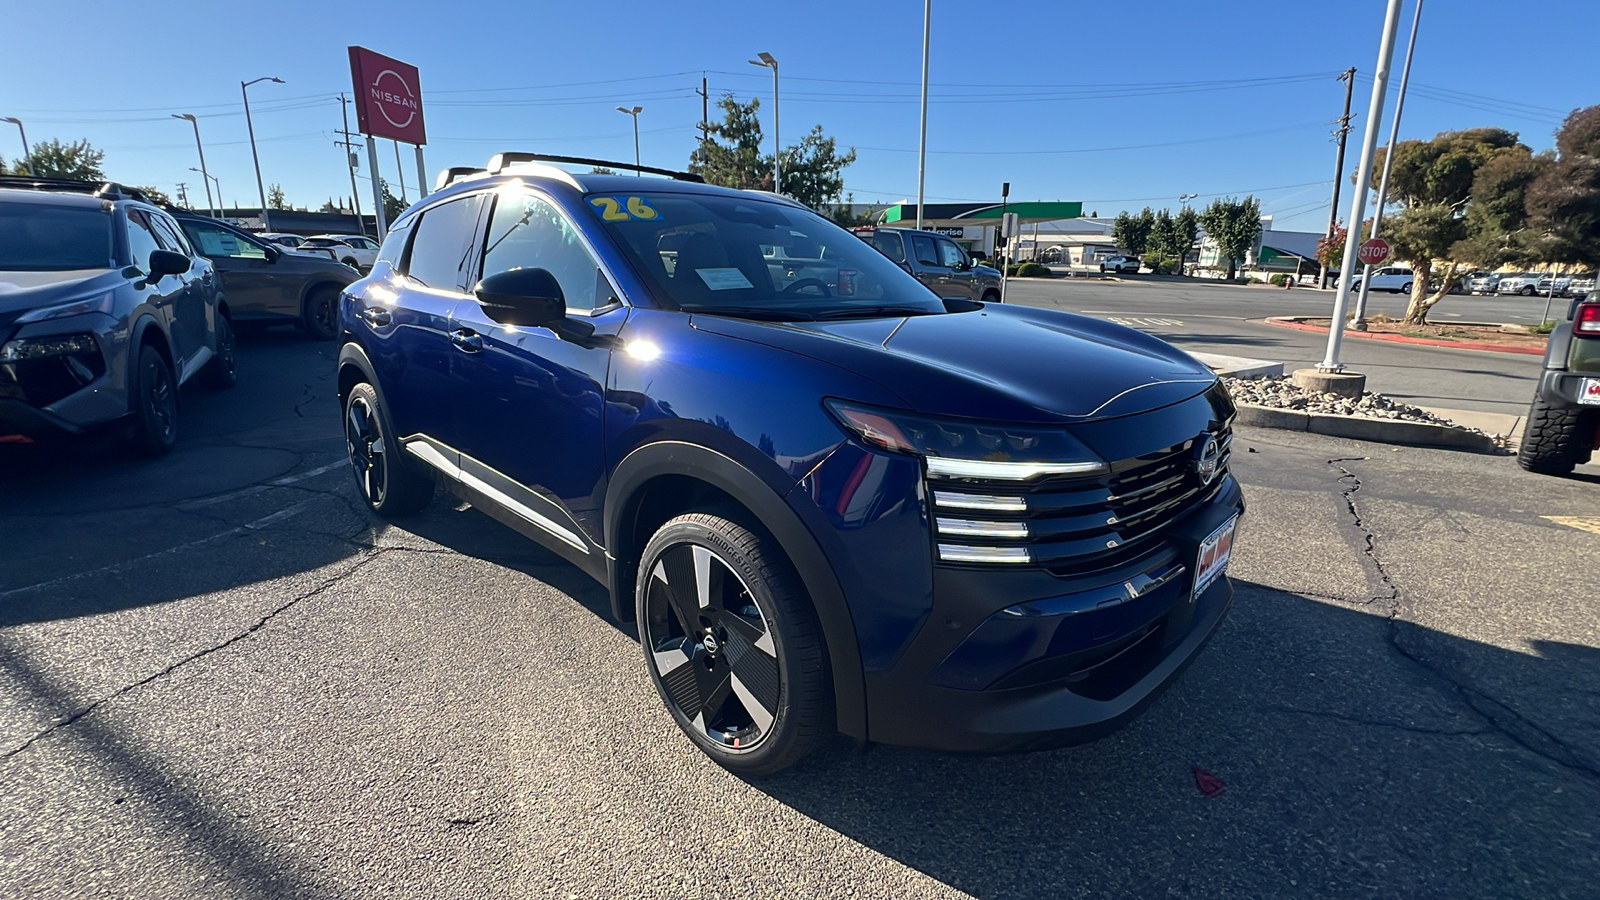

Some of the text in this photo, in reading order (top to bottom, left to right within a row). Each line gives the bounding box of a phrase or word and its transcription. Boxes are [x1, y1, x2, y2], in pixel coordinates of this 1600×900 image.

[371, 88, 417, 110] NISSAN
[590, 196, 658, 220] 26
[1361, 246, 1387, 257] STOP
[1107, 317, 1184, 327] STOP
[706, 531, 761, 588] BRIDGESTONE
